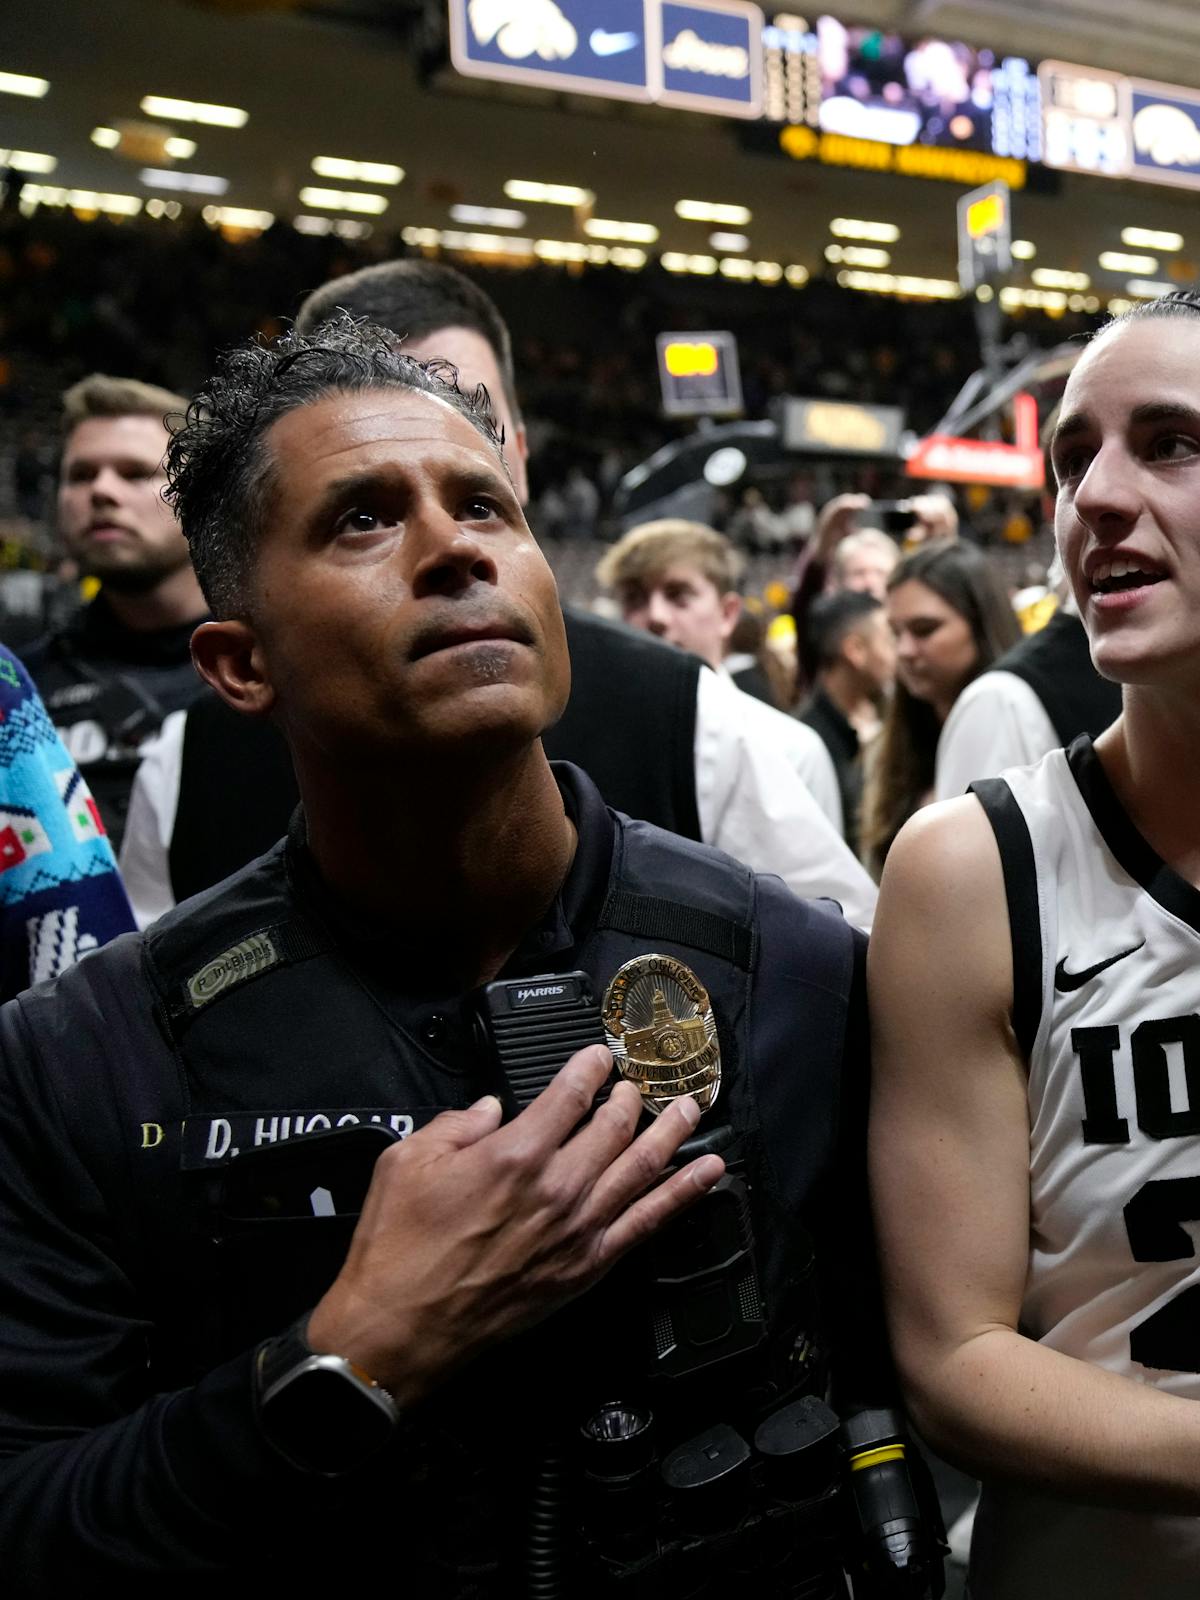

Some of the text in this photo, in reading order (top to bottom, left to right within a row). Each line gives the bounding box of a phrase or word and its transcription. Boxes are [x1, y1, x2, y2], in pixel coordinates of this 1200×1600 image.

[518, 985, 564, 1004] HARRIS
[648, 958, 701, 998] OFFICER
[204, 1118, 240, 1160] D.
